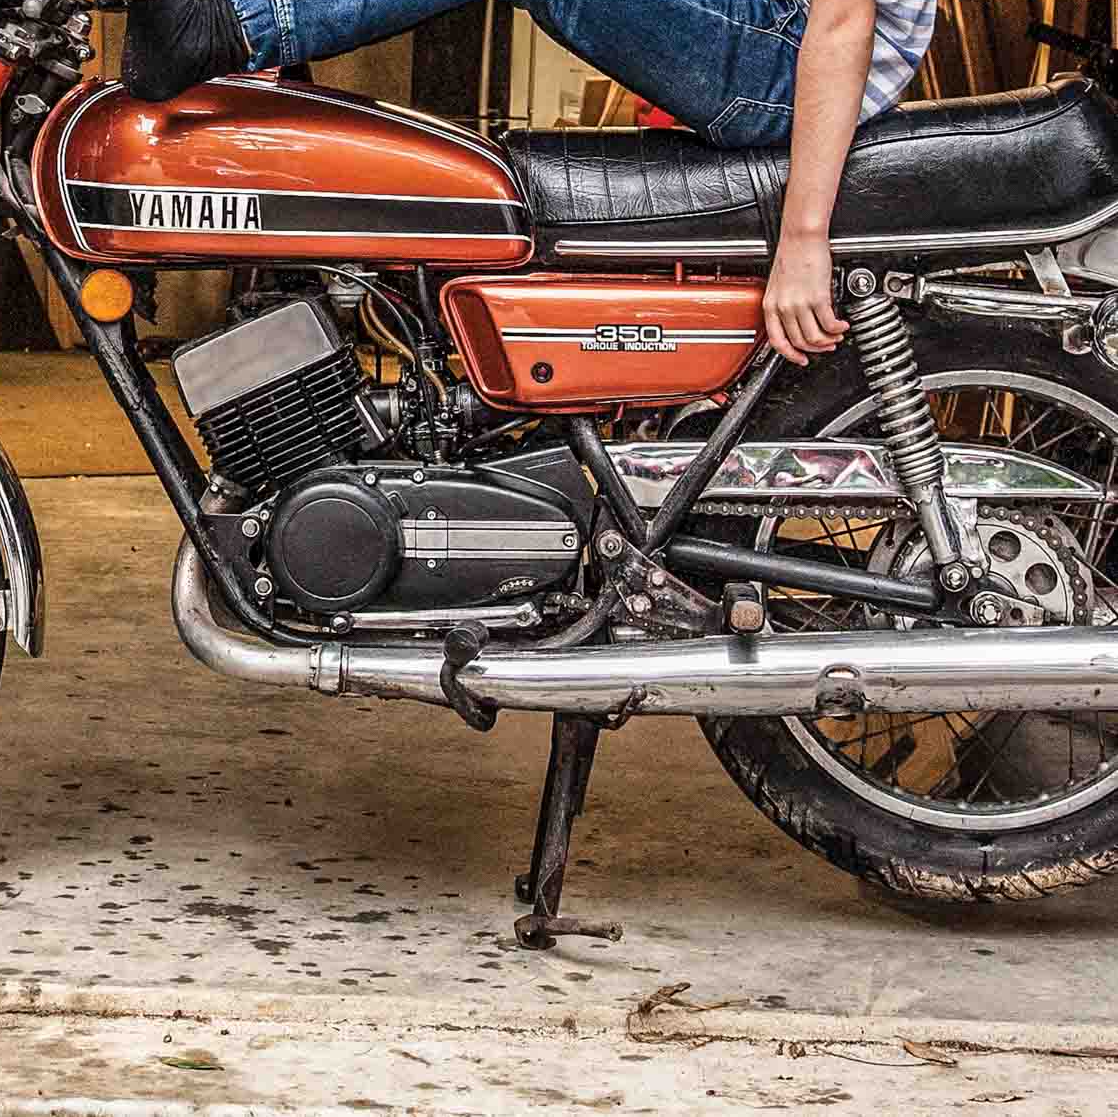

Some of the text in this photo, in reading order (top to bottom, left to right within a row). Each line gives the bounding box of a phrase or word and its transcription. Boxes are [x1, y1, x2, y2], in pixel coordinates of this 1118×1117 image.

[131, 192, 260, 230] YAMAHA
[596, 325, 662, 342] 350
[581, 342, 677, 351] TORQUE INDUCTION
